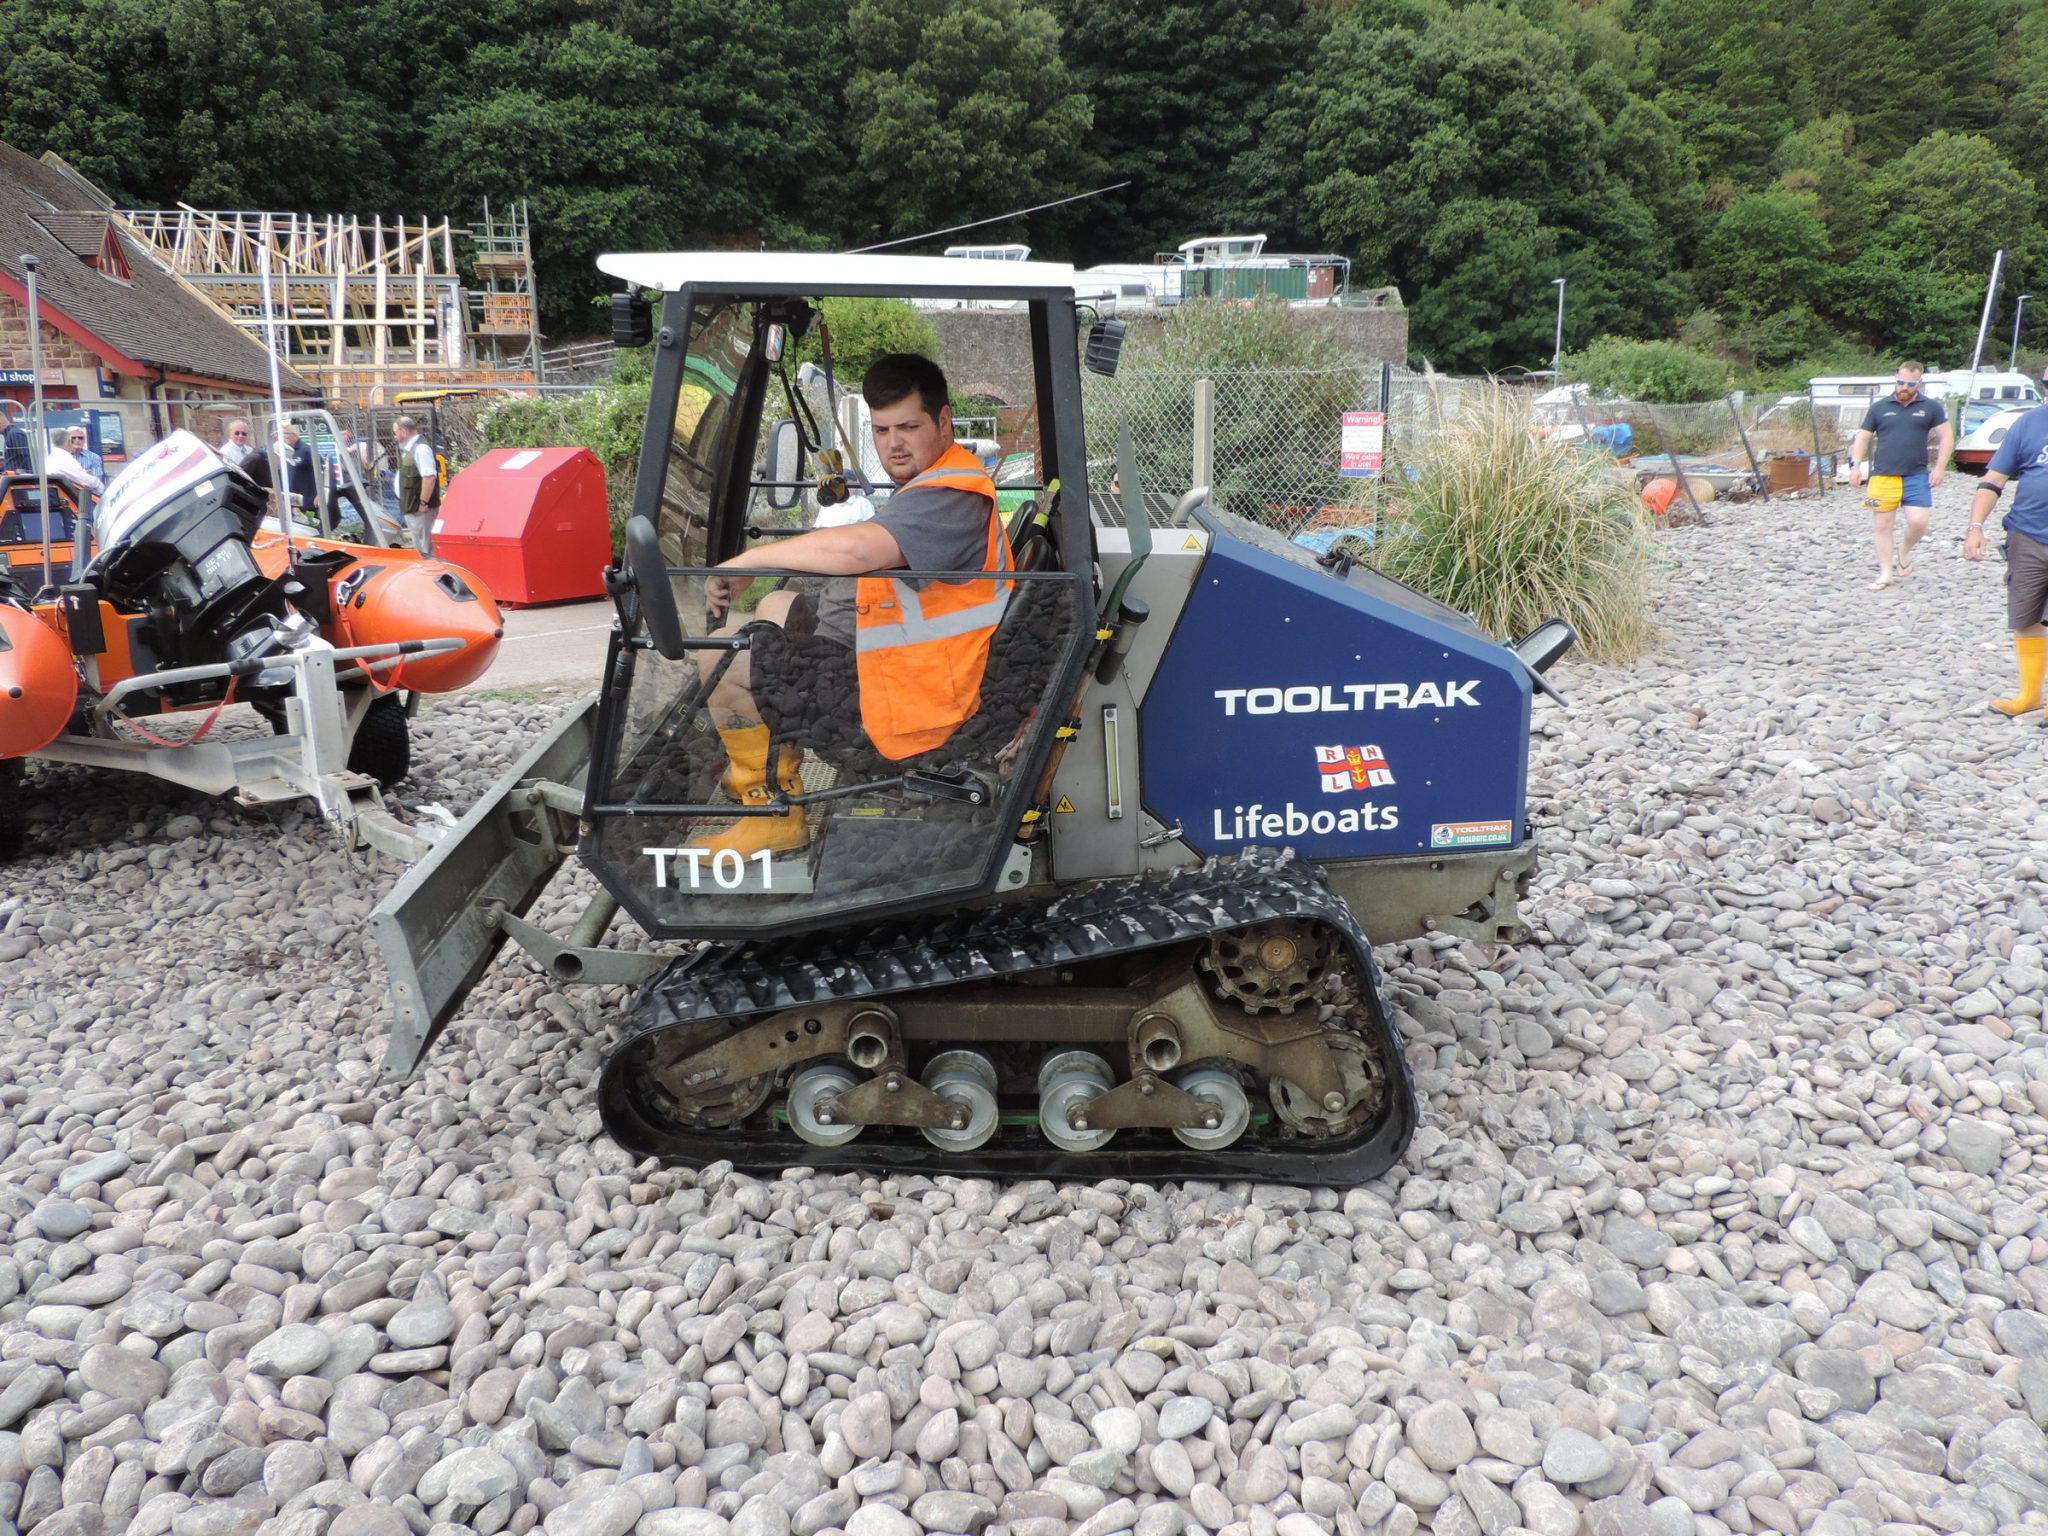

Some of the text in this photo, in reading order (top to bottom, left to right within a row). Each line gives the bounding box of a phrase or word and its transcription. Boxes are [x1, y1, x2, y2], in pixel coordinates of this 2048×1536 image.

[9, 371, 35, 384] shop
[1214, 680, 1481, 716] TOOLTRAK
[1214, 801, 1399, 841] Lifeboats
[1455, 824, 1508, 833] TOOLTRAK
[642, 847, 772, 889] TT01
